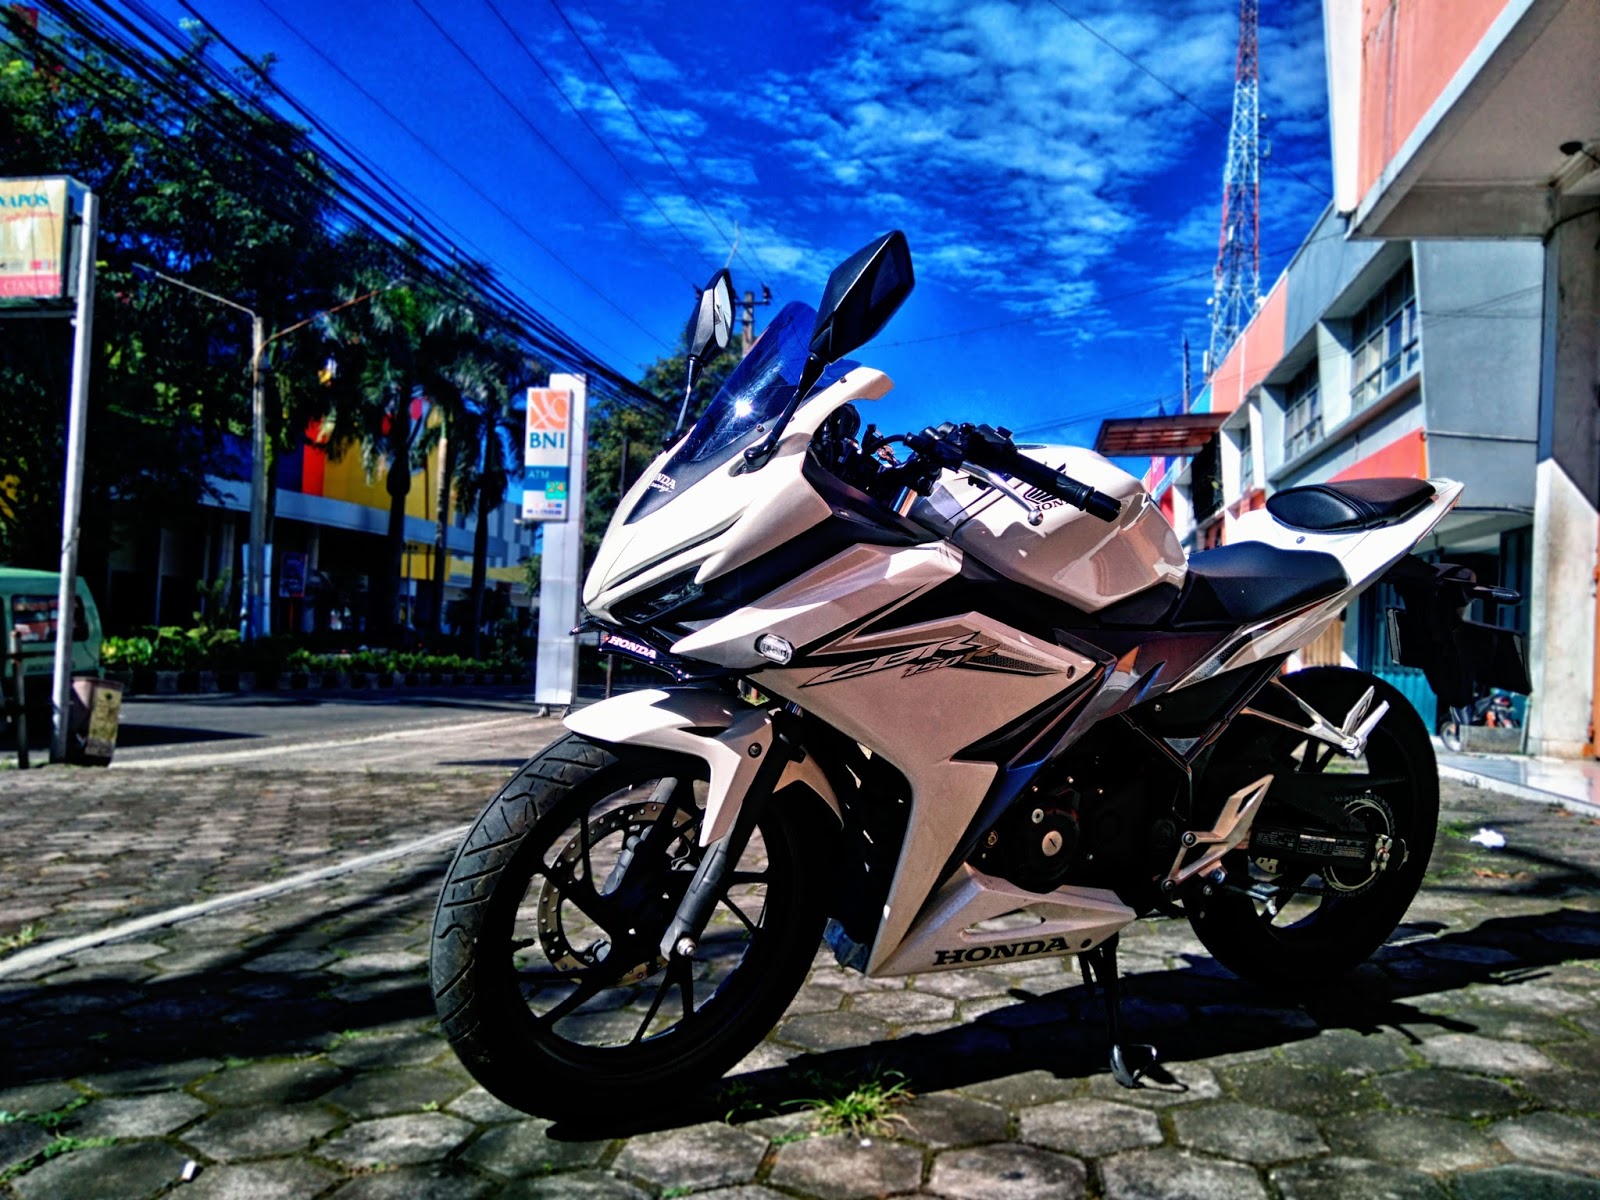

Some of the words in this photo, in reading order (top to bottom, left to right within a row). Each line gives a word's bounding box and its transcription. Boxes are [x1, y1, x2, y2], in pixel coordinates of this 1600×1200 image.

[530, 432, 565, 449] BNI
[528, 470, 550, 479] ATM
[654, 473, 676, 490] NDA
[548, 482, 565, 493] 24
[608, 635, 657, 659] HONDA
[798, 631, 981, 689] CBR
[932, 937, 1070, 966] HONDA
